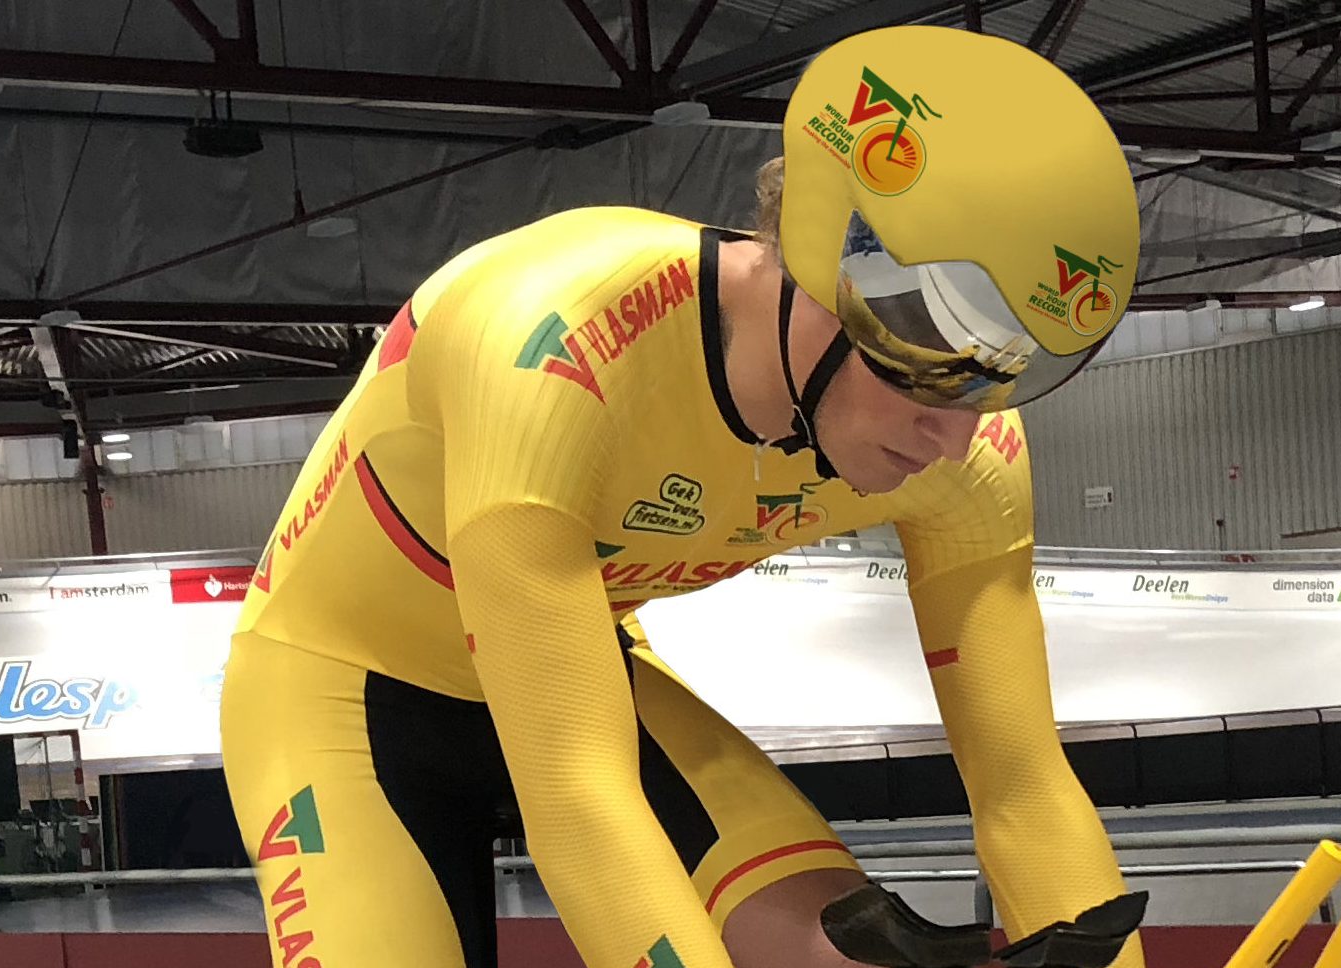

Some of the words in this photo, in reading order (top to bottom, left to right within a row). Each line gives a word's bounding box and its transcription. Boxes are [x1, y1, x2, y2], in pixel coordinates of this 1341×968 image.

[824, 103, 848, 125] WORLD
[808, 116, 851, 155] RECORD
[829, 119, 855, 143] HOUR
[1029, 294, 1066, 318] RECORD
[1046, 294, 1068, 308] HOUR
[576, 257, 695, 365] VLASMAN
[280, 430, 349, 551] VLASMAN
[668, 482, 695, 501] Gek
[754, 560, 789, 576] elen
[866, 561, 909, 580] Deel
[1132, 575, 1190, 594] Deelen
[1273, 578, 1335, 591] dimension
[1307, 591, 1334, 603] data
